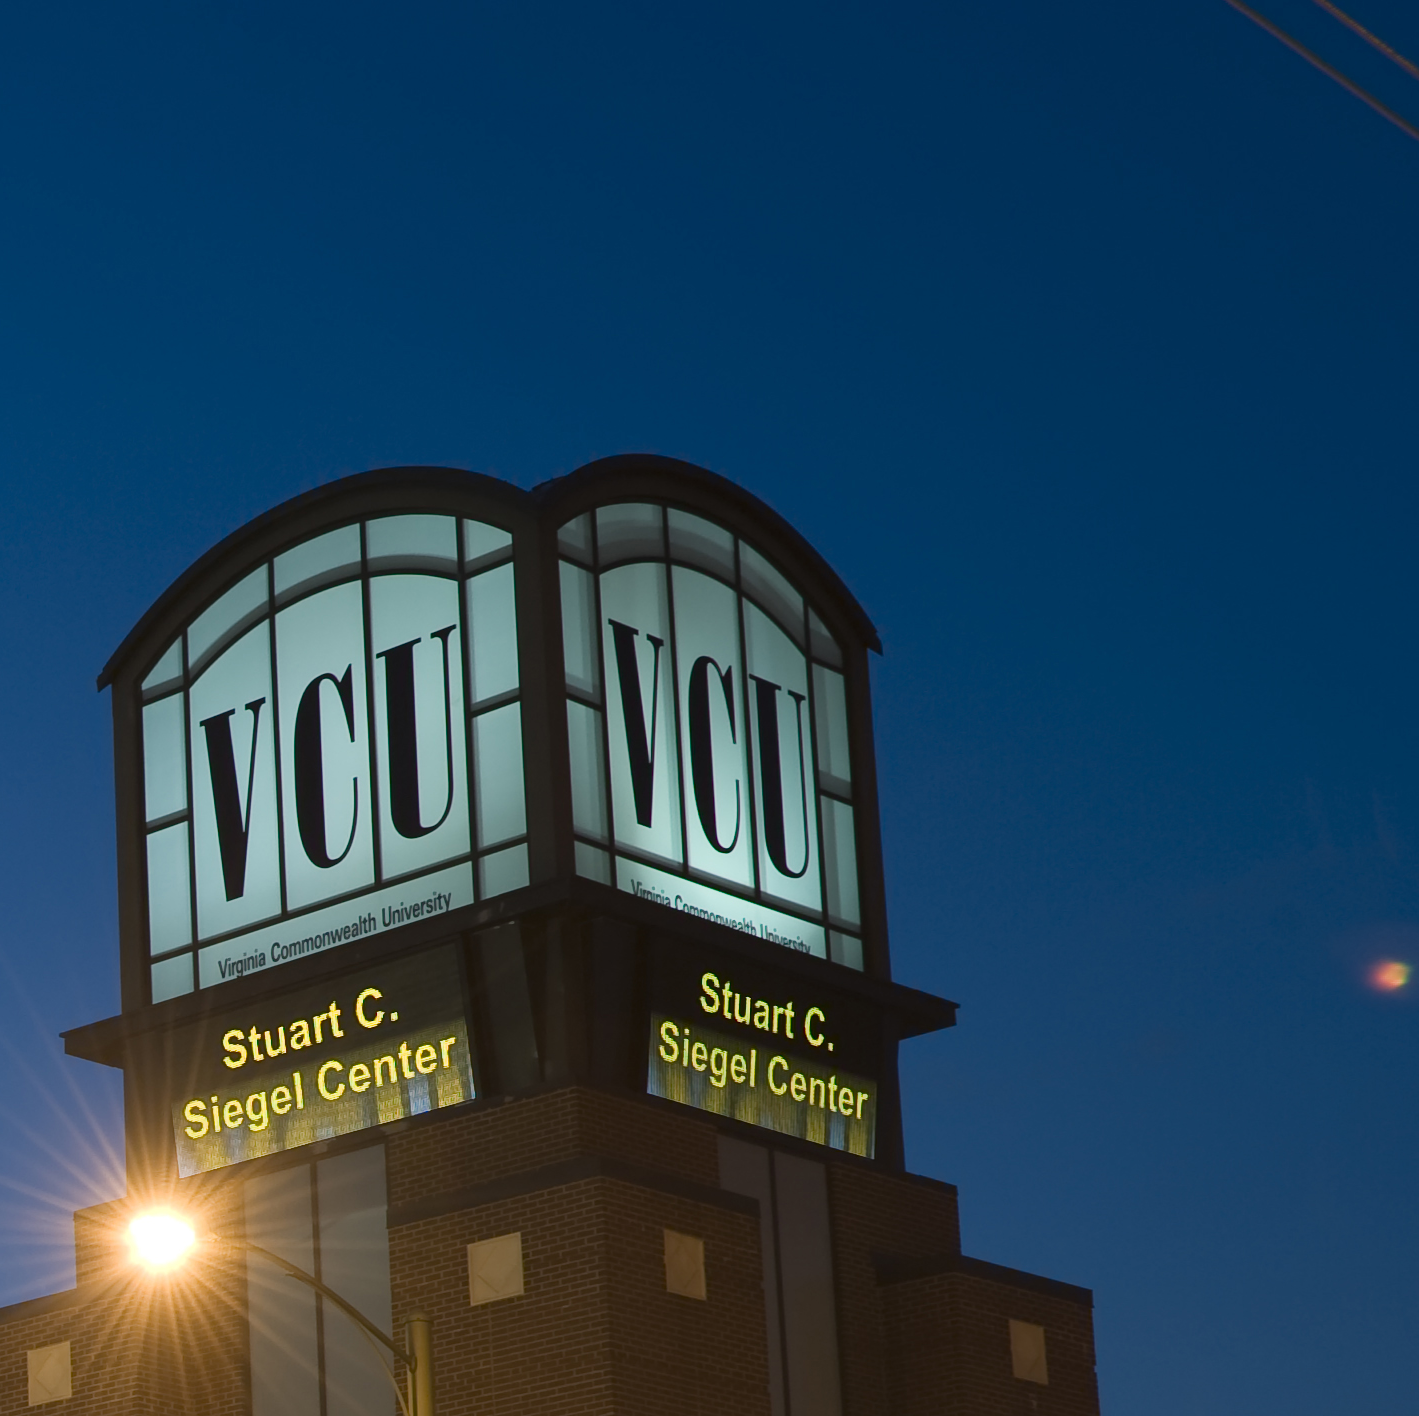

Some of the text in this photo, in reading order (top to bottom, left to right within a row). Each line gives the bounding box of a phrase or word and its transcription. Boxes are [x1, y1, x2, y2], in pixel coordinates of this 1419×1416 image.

[199, 624, 458, 902] VCU
[608, 619, 811, 878] VCU
[218, 891, 452, 978] Virginia Commonwealth University
[222, 987, 399, 1069] Stuart C.
[699, 972, 835, 1052] Stuart C.
[183, 1036, 456, 1139] Siegel Center
[658, 1021, 868, 1119] Siegel Center
